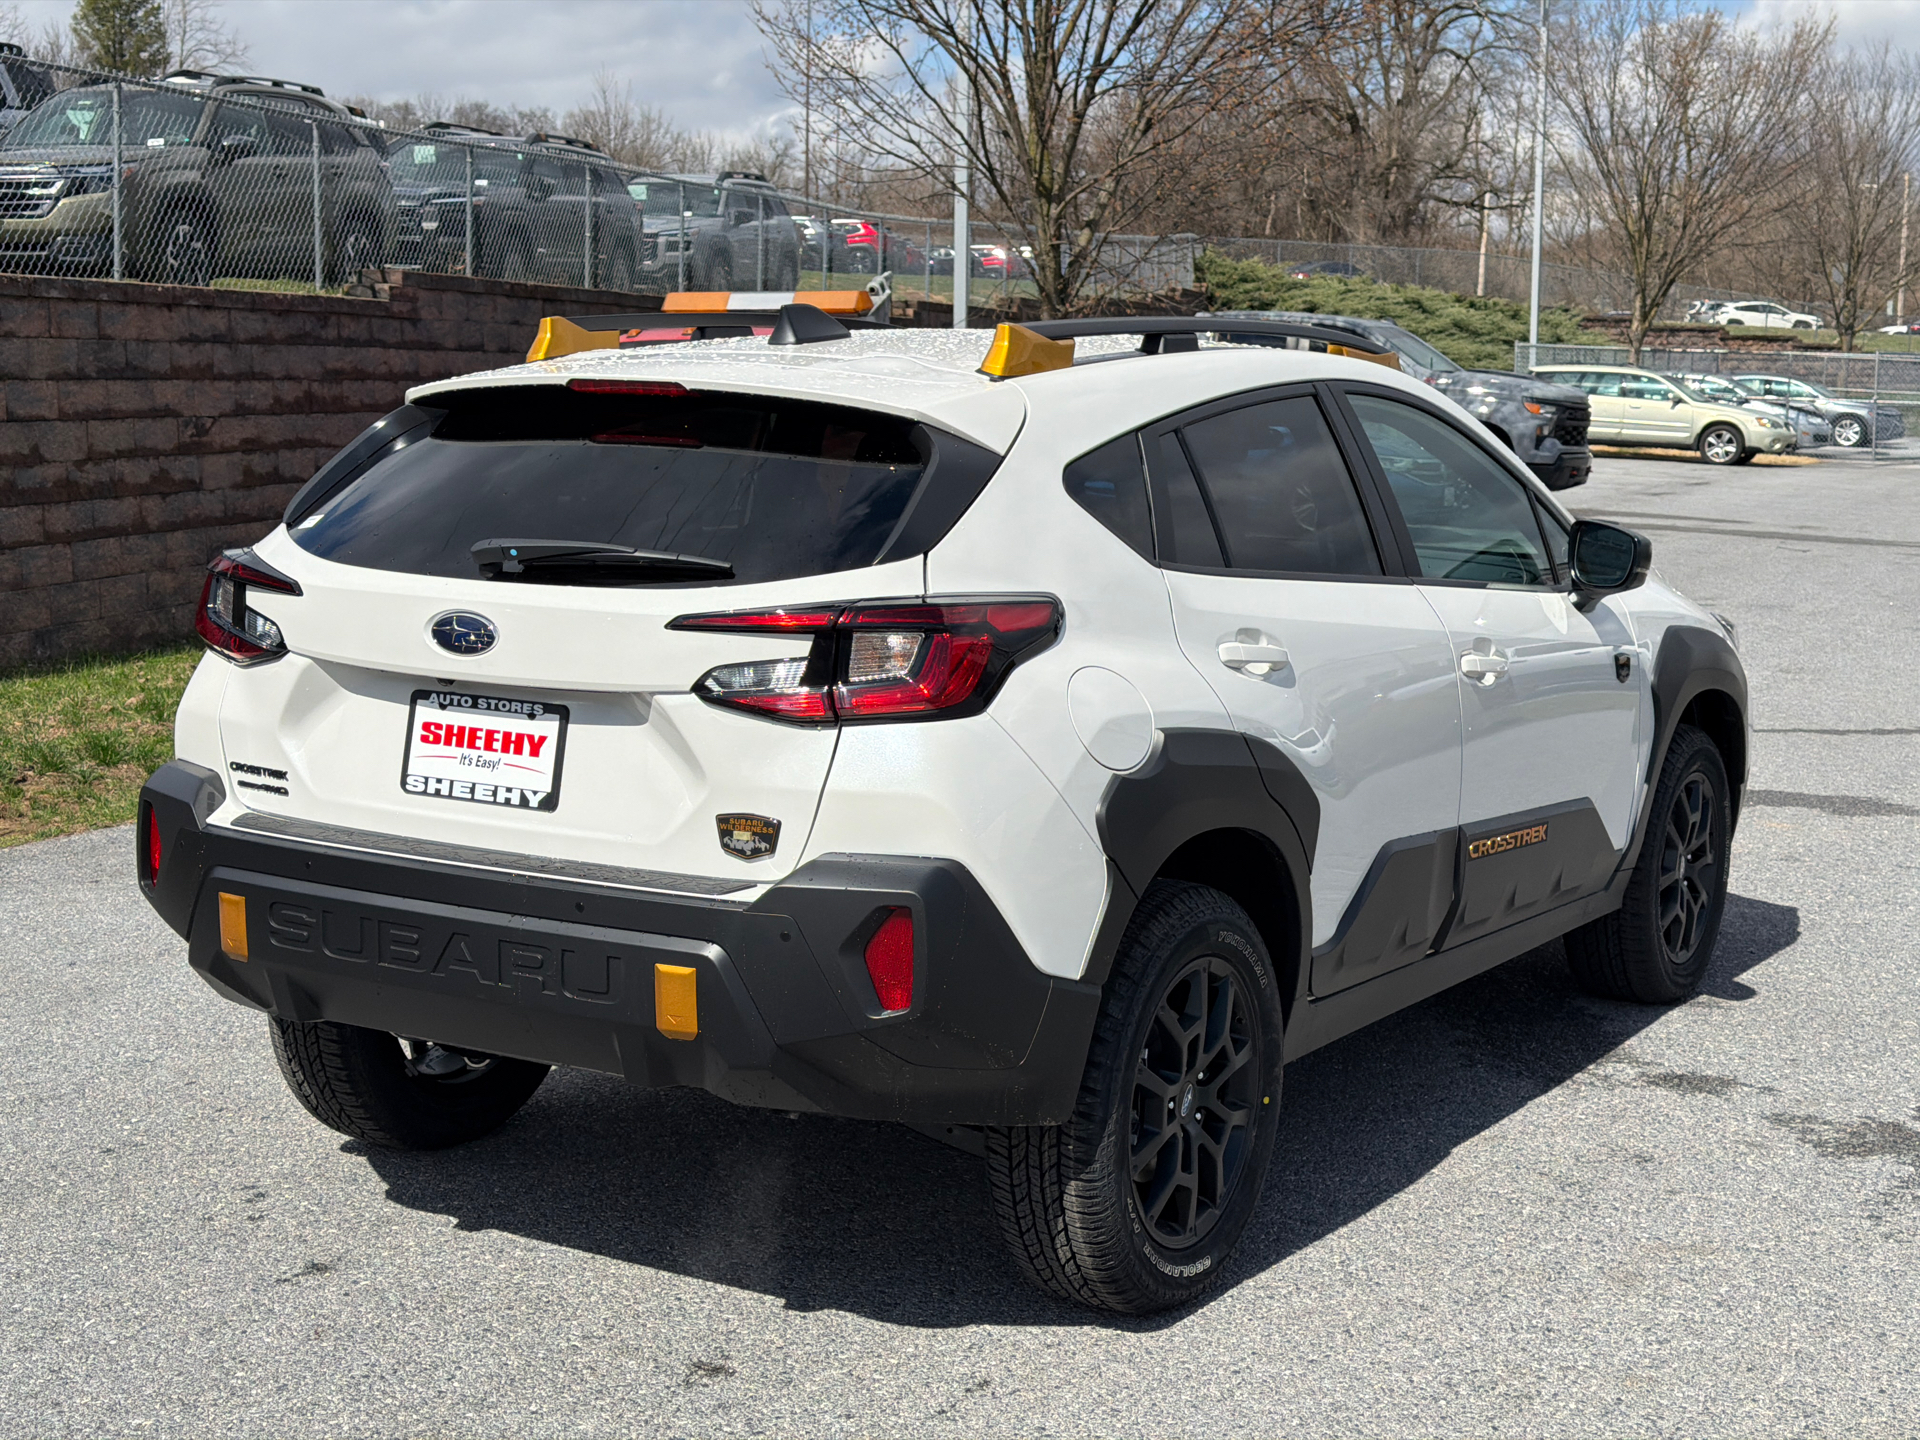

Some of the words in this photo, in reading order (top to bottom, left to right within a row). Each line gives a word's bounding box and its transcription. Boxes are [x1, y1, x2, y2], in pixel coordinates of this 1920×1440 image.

[428, 693, 472, 707] AUTO
[477, 698, 544, 716] STORES
[420, 721, 548, 758] SHEEHY
[459, 753, 473, 767] It's
[475, 755, 502, 772] Easy!
[405, 775, 548, 808] SHEEHY
[720, 823, 774, 834] WILDERNESS
[729, 818, 764, 827] SUBARU
[1469, 824, 1547, 858] CROSSTREK
[268, 901, 622, 1005] SUBARU
[1218, 930, 1268, 989] YOKOHAMA
[1143, 1241, 1212, 1277] GEOLANDAR
